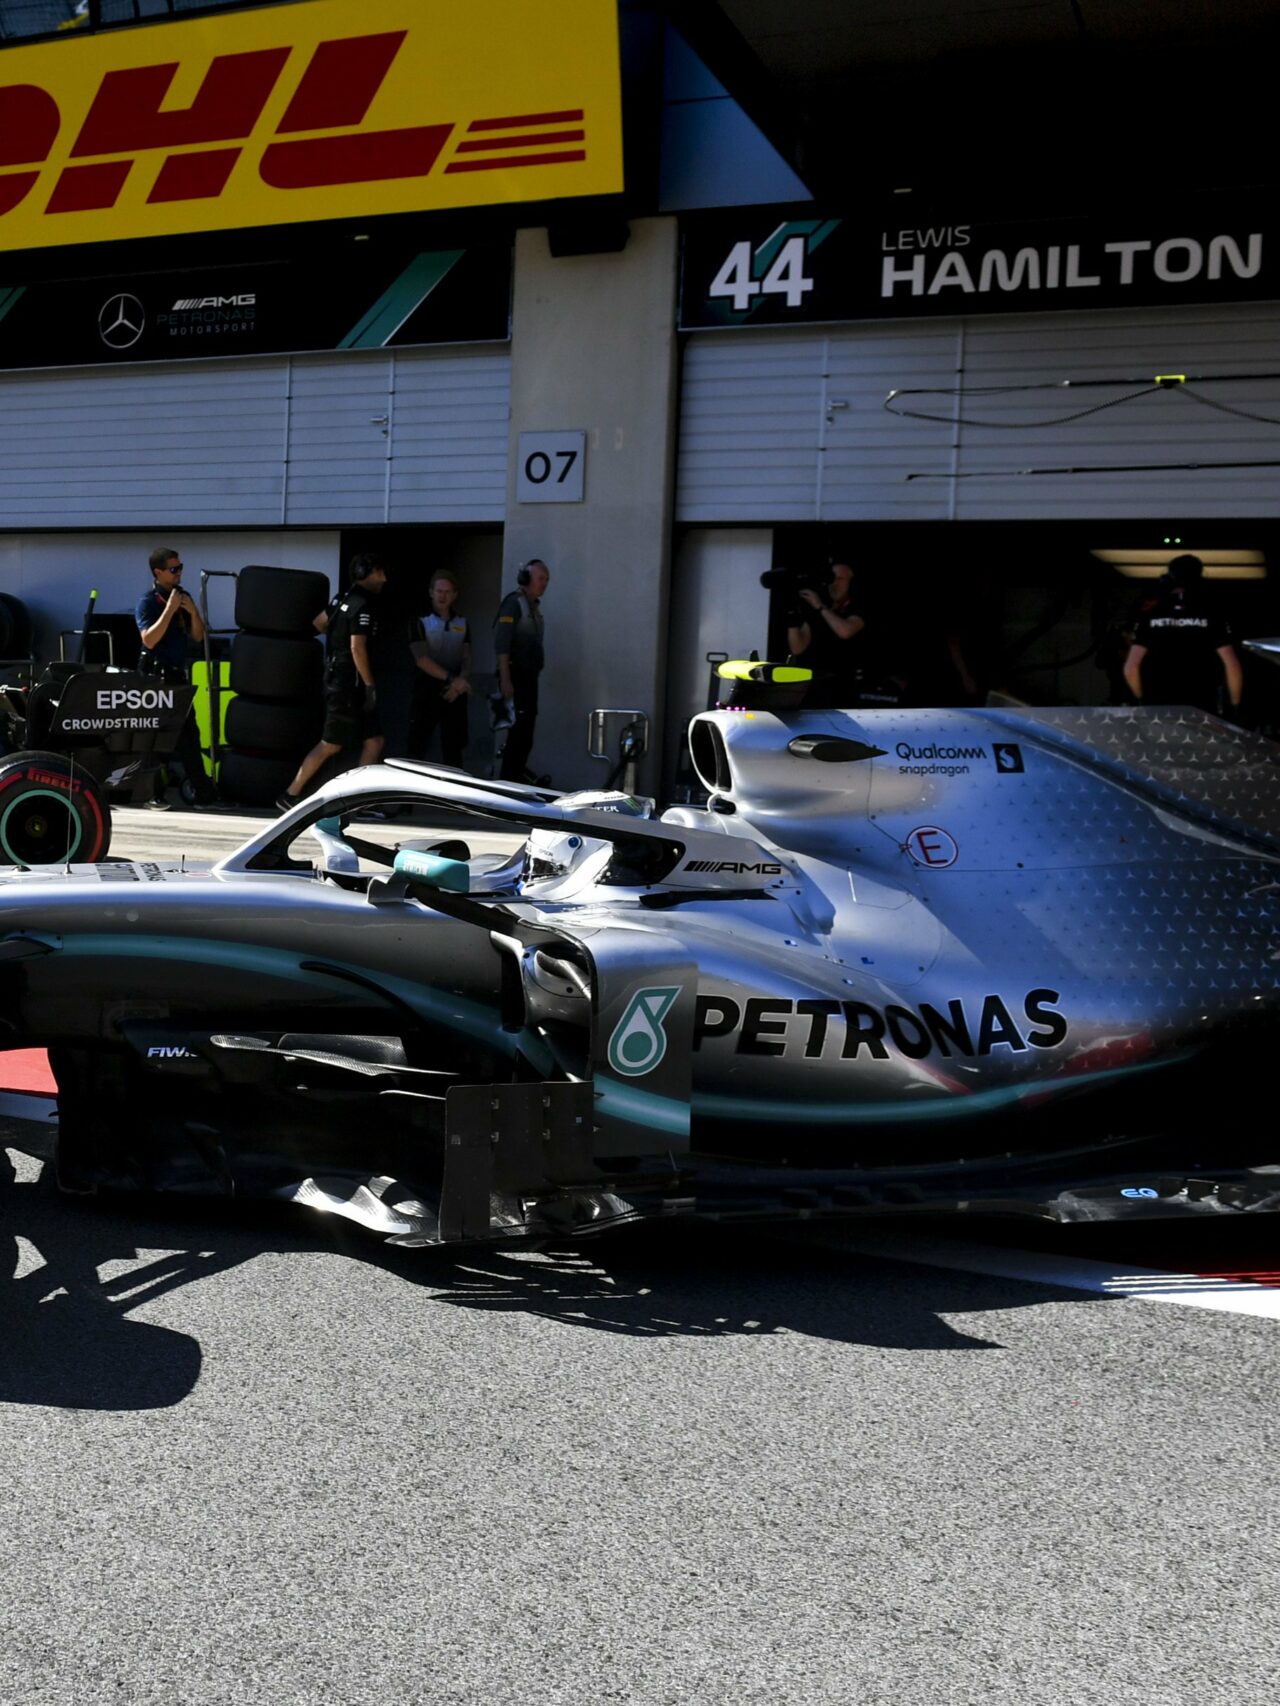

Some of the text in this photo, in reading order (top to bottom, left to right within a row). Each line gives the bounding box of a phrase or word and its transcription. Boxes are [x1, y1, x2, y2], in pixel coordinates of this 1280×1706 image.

[881, 226, 972, 251] LEWIS
[709, 237, 814, 310] 44
[881, 233, 1263, 297] HAMILTON
[199, 293, 256, 309] AMG
[156, 308, 256, 326] PETRONAS
[169, 322, 255, 336] MOTORSPORT
[524, 450, 578, 484] 07
[96, 689, 174, 710] EPSON
[61, 717, 160, 731] CROWDSTRIKE
[895, 742, 988, 761] Qualcomm
[899, 763, 970, 777] snapdragon
[916, 830, 949, 865] E
[715, 861, 782, 875] AMG
[692, 987, 1069, 1062] PETRONAS
